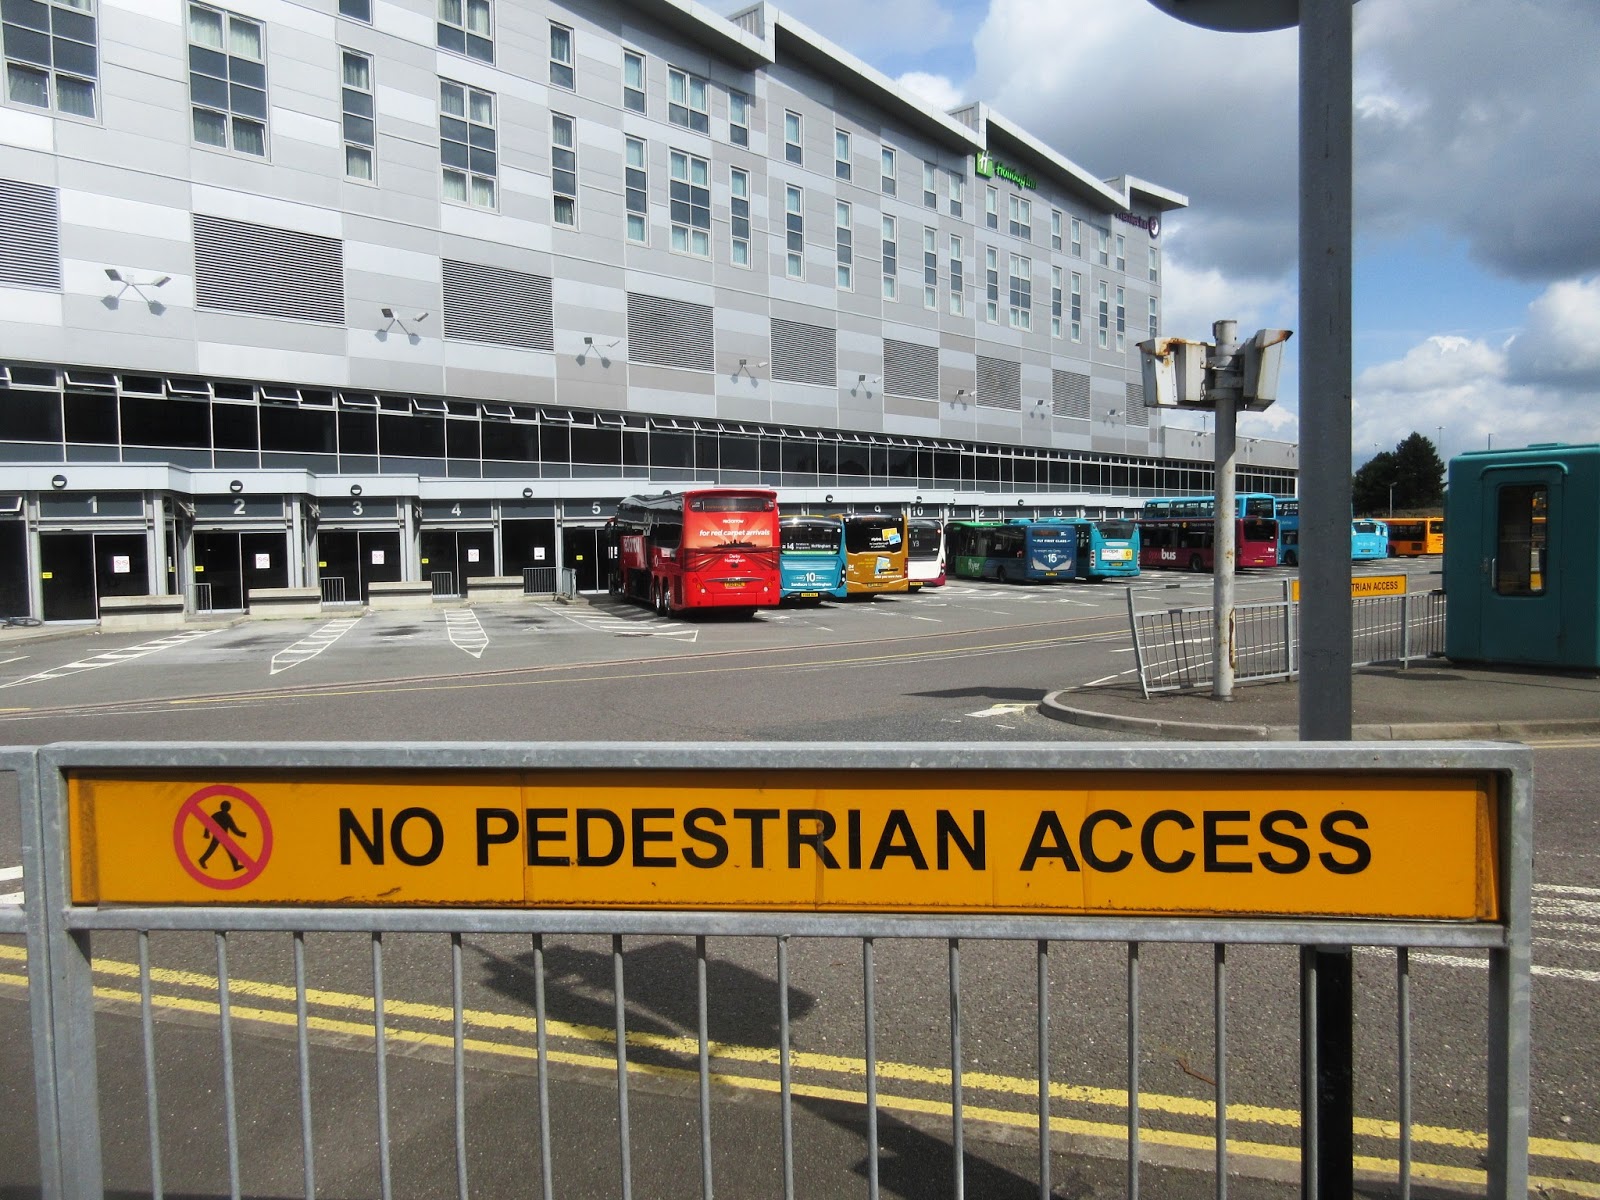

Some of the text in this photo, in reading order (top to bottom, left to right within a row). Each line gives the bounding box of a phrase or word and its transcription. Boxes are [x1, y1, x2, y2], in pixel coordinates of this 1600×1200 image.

[996, 165, 1025, 188] Holiday
[87, 496, 98, 513] 1
[233, 499, 246, 515] 2
[352, 501, 363, 515] 3
[451, 503, 461, 516] 4
[591, 502, 601, 514] 5
[912, 507, 924, 516] 10
[1052, 508, 1062, 516] 13
[1047, 553, 1057, 563] 15
[968, 558, 980, 572] flyer
[805, 572, 816, 582] 10
[1352, 581, 1398, 592] TRIAN ACCESS
[339, 805, 1373, 875] NO PEDESTRIAN ACCESS
